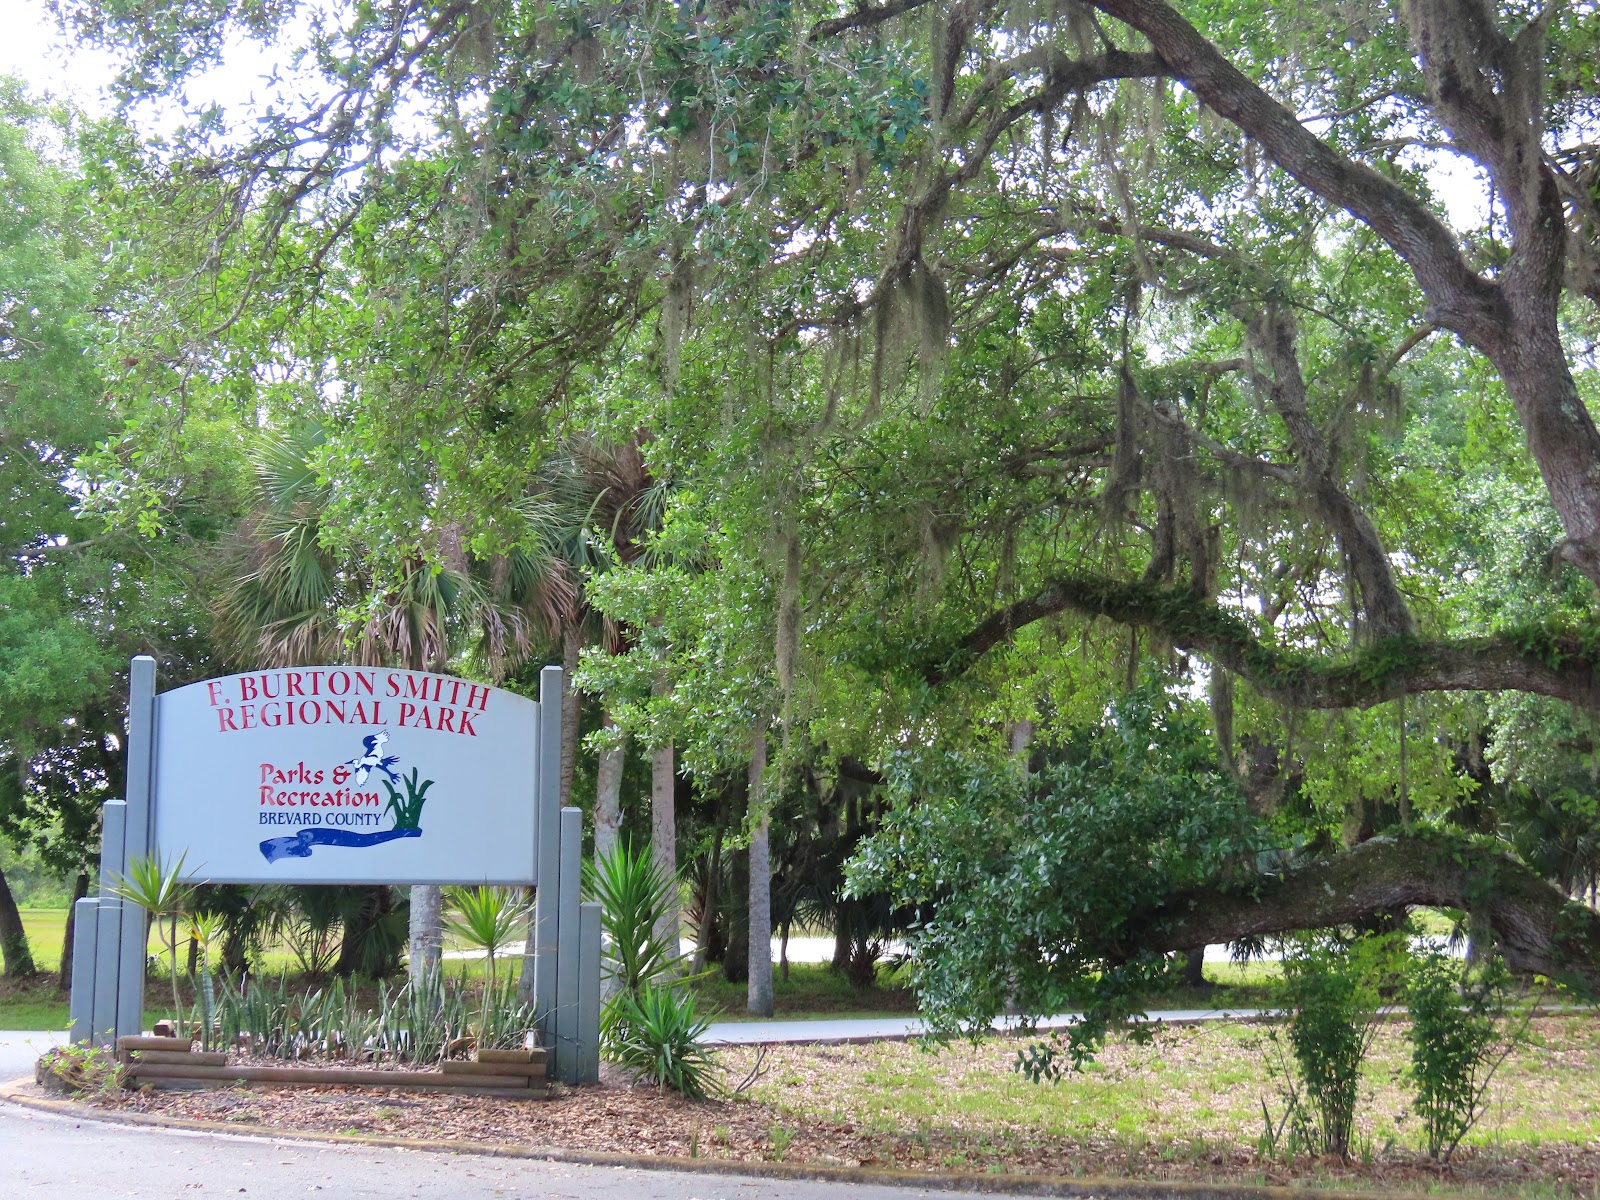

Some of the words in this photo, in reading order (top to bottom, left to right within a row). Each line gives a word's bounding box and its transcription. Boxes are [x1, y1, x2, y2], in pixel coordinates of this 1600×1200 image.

[206, 681, 231, 707] F.
[238, 671, 376, 702] BURTON
[385, 673, 492, 712] SMITH
[216, 700, 388, 733] REGIONAL
[398, 702, 480, 737] PARK
[259, 761, 324, 785] Parks
[332, 765, 352, 786] &
[258, 785, 380, 807] Recreation
[258, 811, 322, 825] BREVARD
[325, 811, 382, 826] COUNTY
